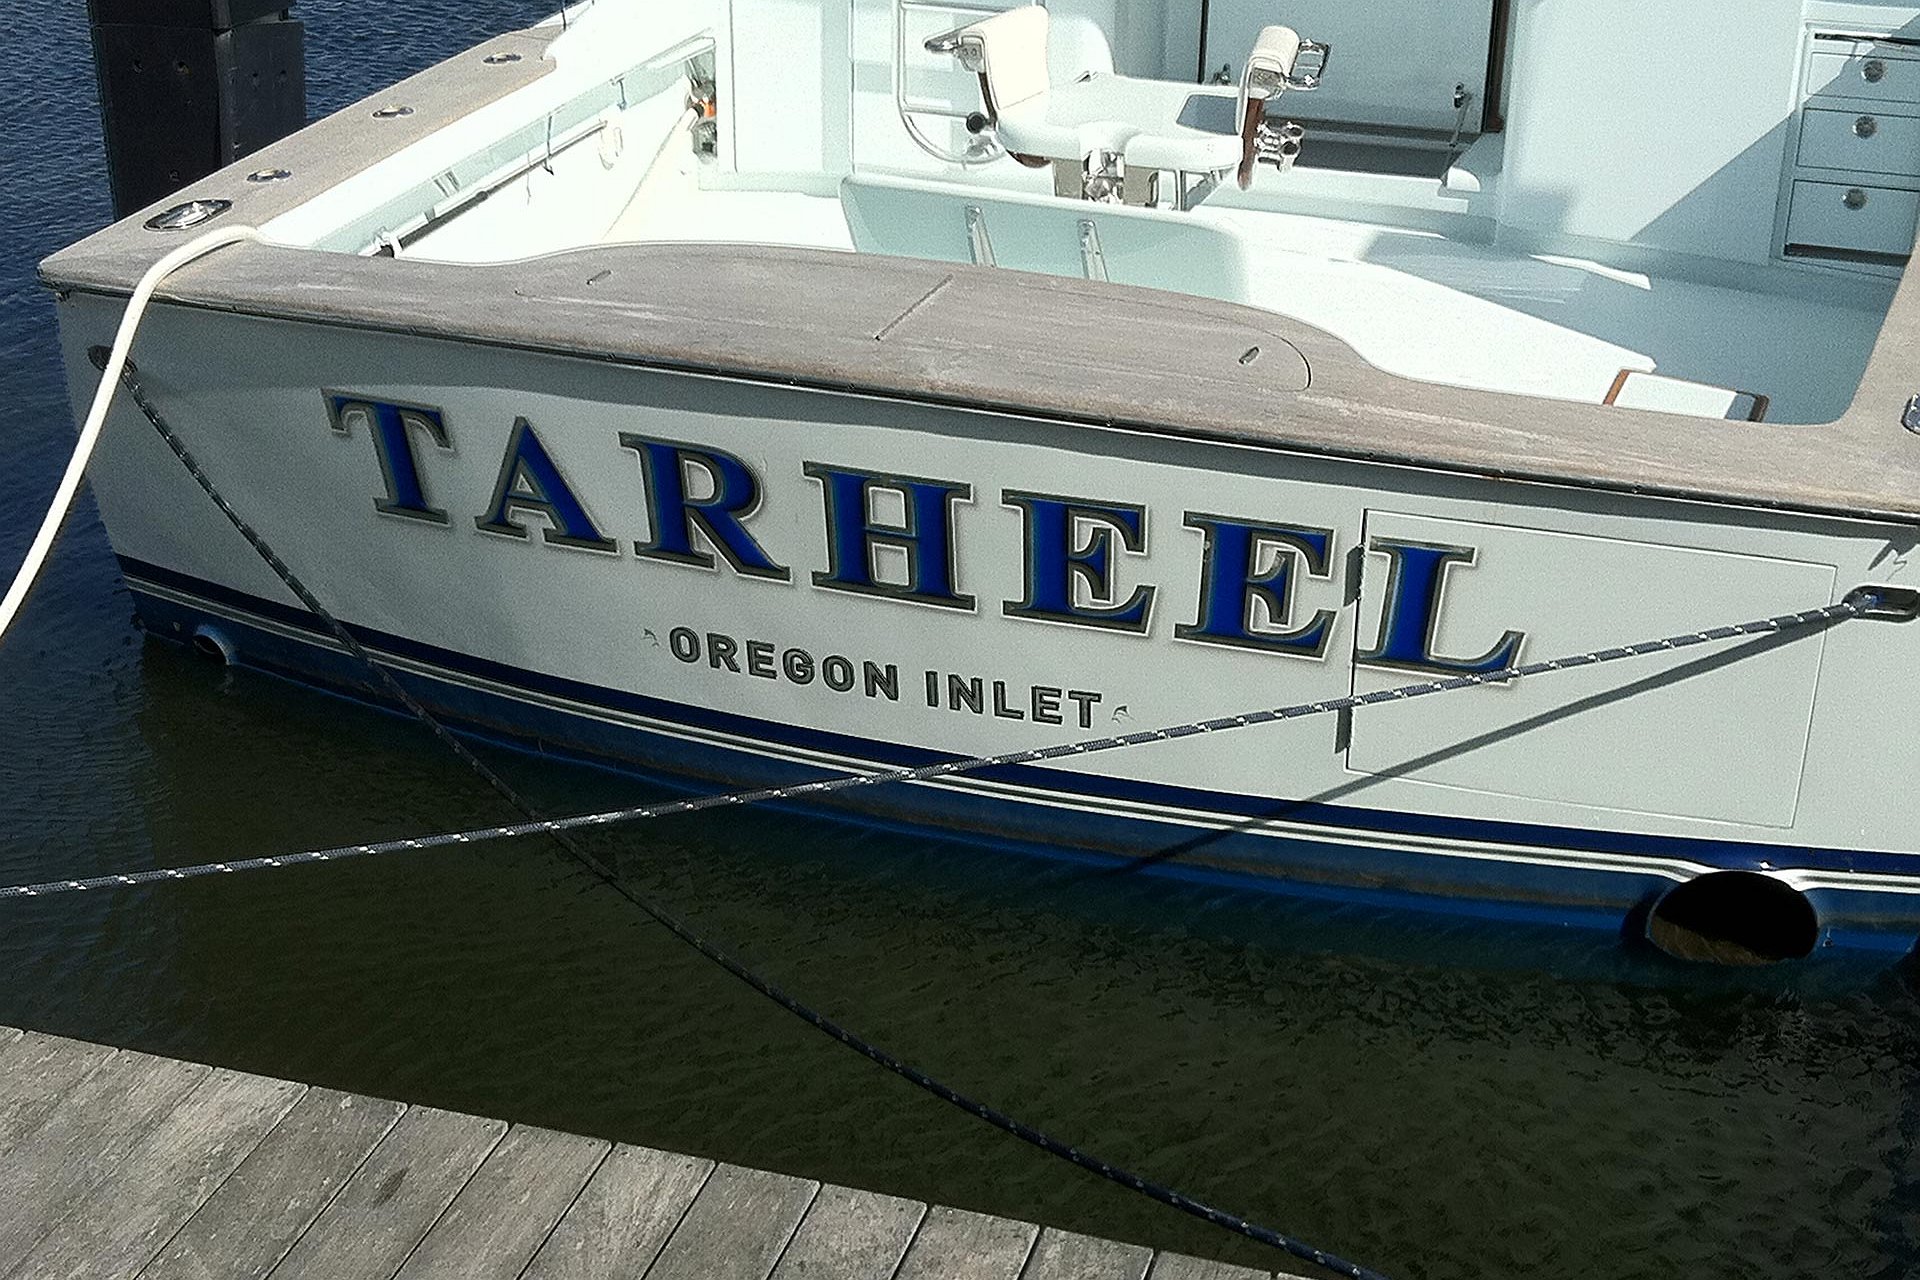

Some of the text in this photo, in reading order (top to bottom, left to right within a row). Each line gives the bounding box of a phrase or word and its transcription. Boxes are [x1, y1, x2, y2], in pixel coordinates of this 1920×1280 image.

[321, 387, 1528, 684] TARHEEL
[670, 626, 1102, 729] OREGON INLET
